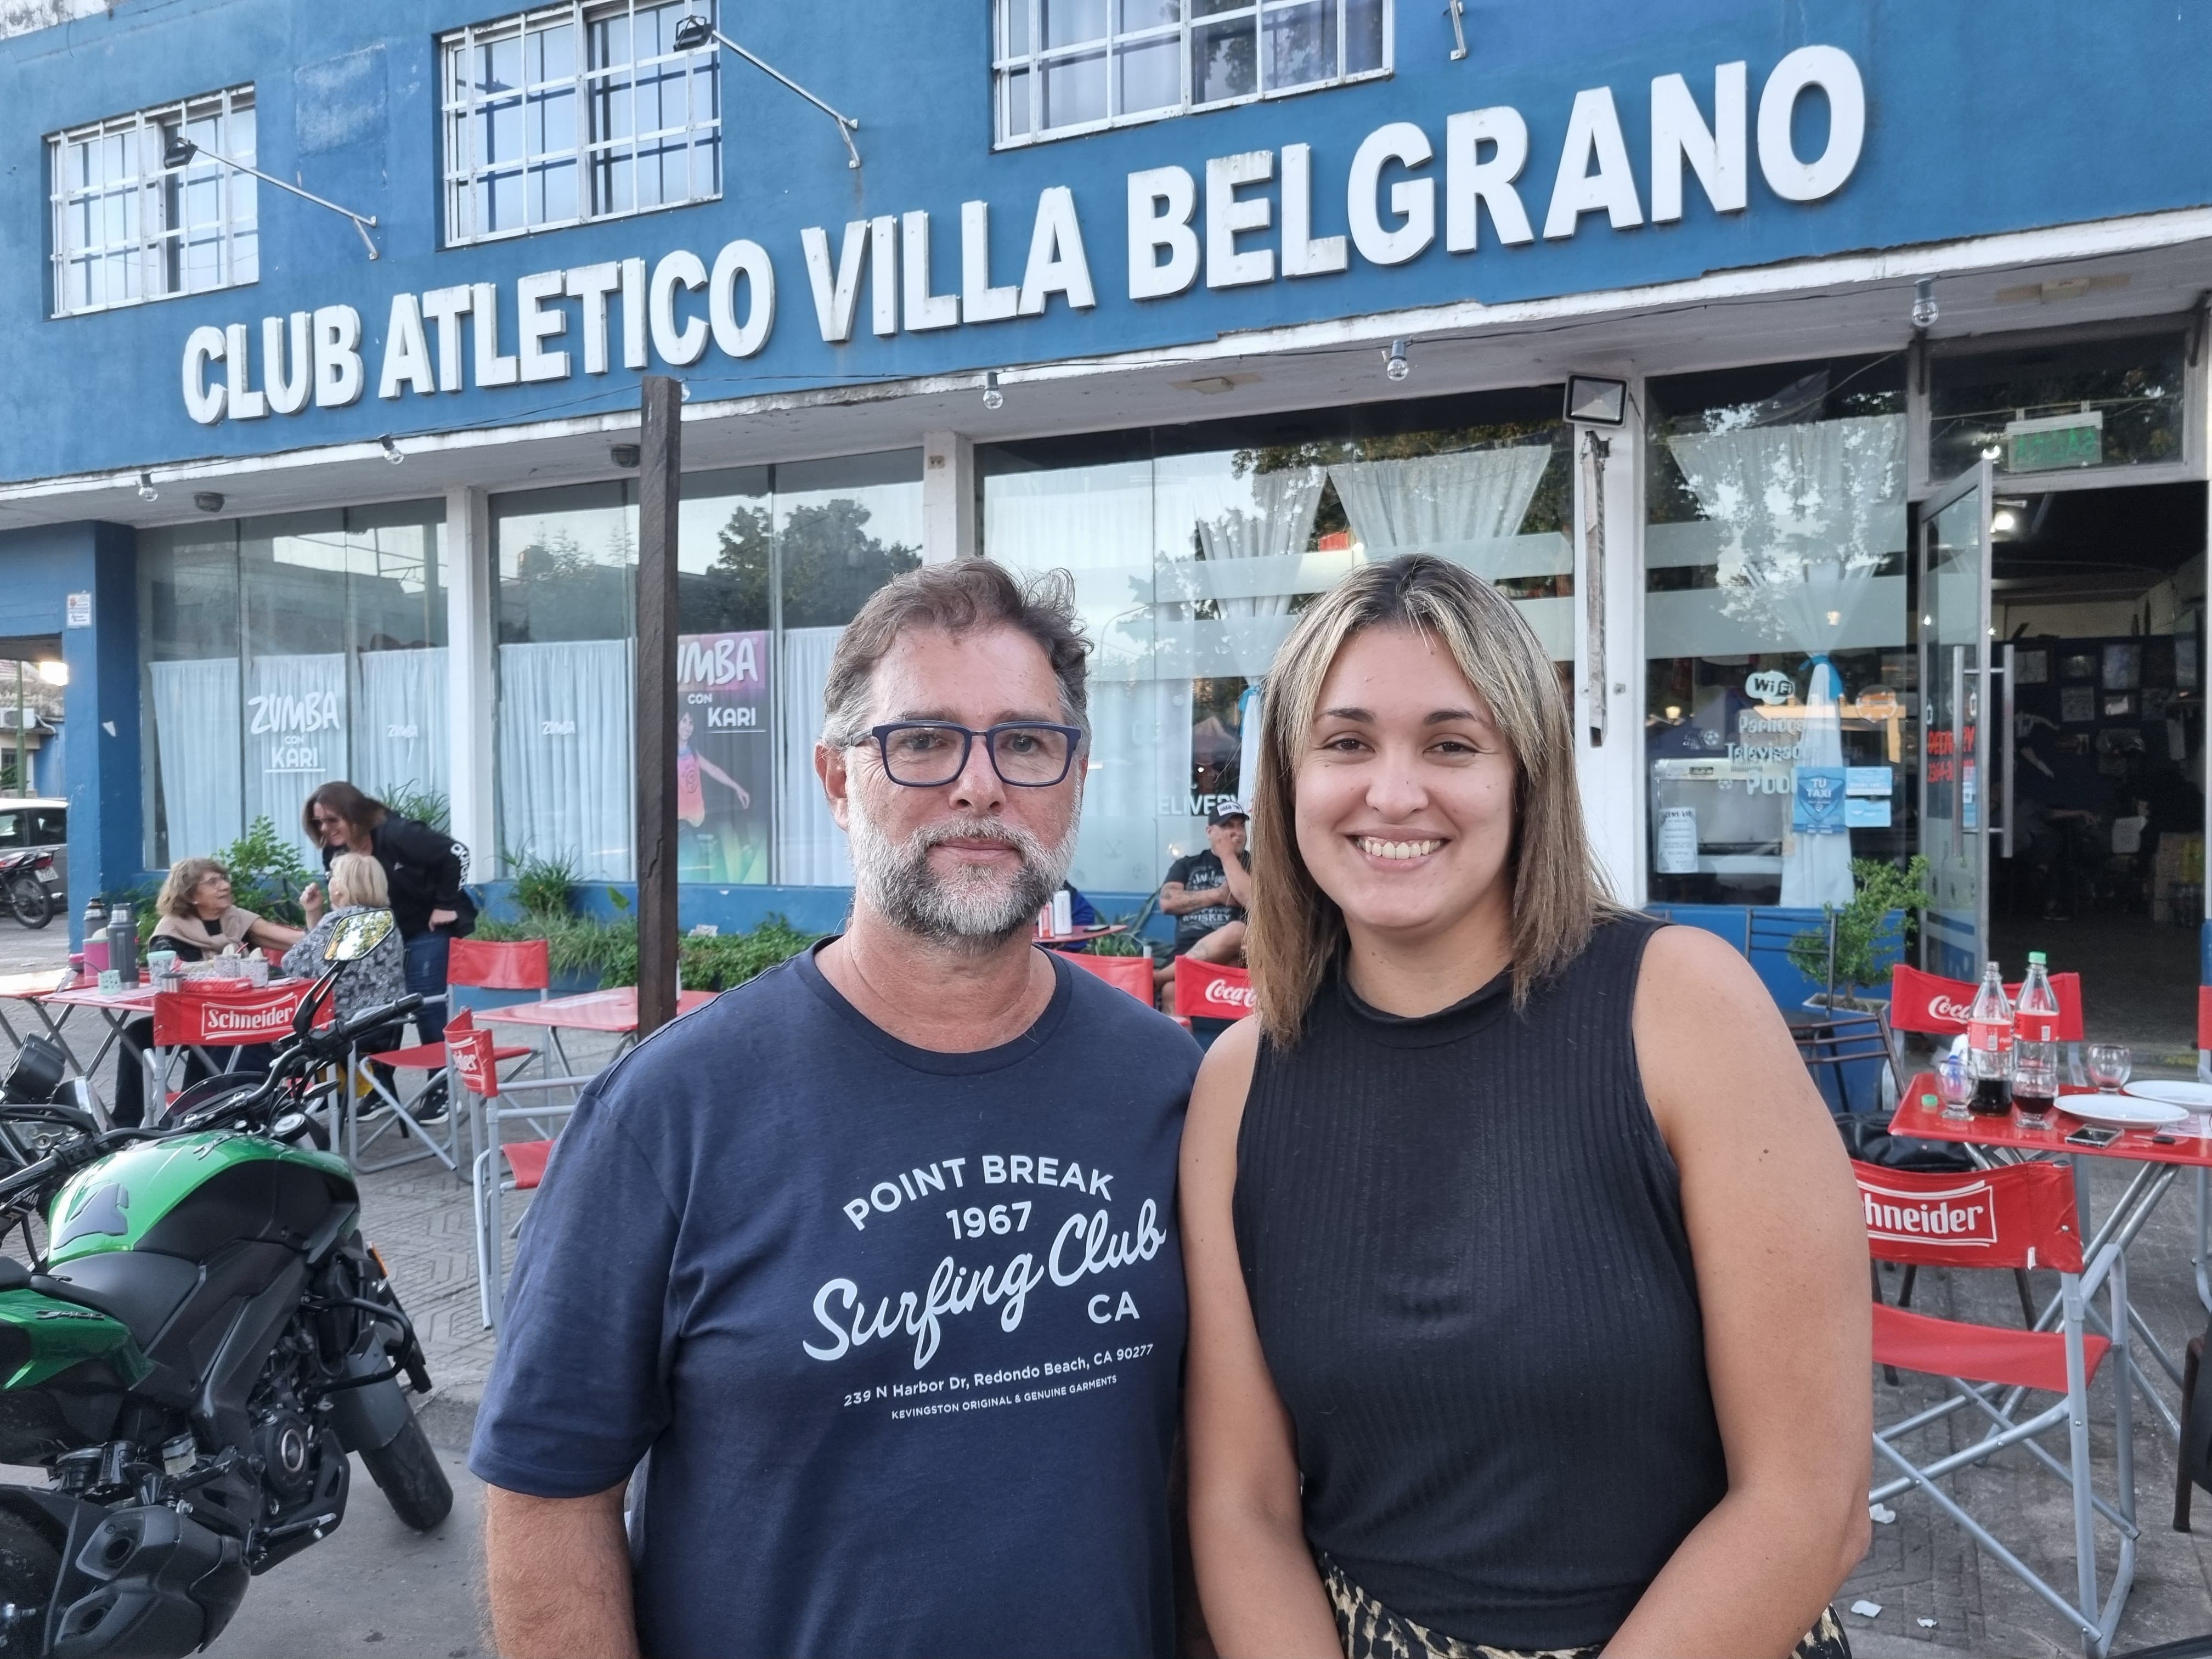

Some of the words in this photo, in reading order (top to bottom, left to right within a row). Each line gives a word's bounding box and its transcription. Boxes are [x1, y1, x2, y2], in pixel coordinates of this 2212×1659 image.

[182, 304, 364, 425] CLUB
[378, 239, 776, 399] ATLETICO
[800, 185, 1096, 342] VILLA
[1127, 45, 1865, 300] BELGRANO
[247, 691, 340, 735] ZUMBA
[687, 693, 713, 704] CON
[707, 707, 757, 727] KARI
[272, 746, 319, 769] KARI
[284, 735, 304, 745] CON
[1807, 788, 1831, 798] TAXI
[1812, 778, 1827, 788] TU
[207, 1006, 294, 1030] Schneider
[843, 1158, 966, 1231] POINT
[982, 1155, 1114, 1201] BREAK
[946, 1200, 1032, 1239] 1967
[1862, 1193, 1984, 1234] hneider
[803, 1252, 1045, 1370] Surfing
[1048, 1198, 1166, 1286] Club
[1087, 1291, 1140, 1324] CA
[844, 1390, 871, 1407] 239
[876, 1386, 888, 1398] N
[893, 1379, 945, 1397] Harbor
[950, 1377, 970, 1391] Dr,
[974, 1365, 1040, 1386] Redondo
[1044, 1357, 1090, 1375] Beach,
[1094, 1351, 1113, 1365] CA
[1116, 1344, 1153, 1361] 90277
[892, 1403, 959, 1420] KEVINGSTON
[962, 1396, 1012, 1410] ORIGINAL
[1015, 1394, 1022, 1403] &
[1024, 1386, 1066, 1401] GENUINE
[1069, 1375, 1117, 1393] GARMENTS
